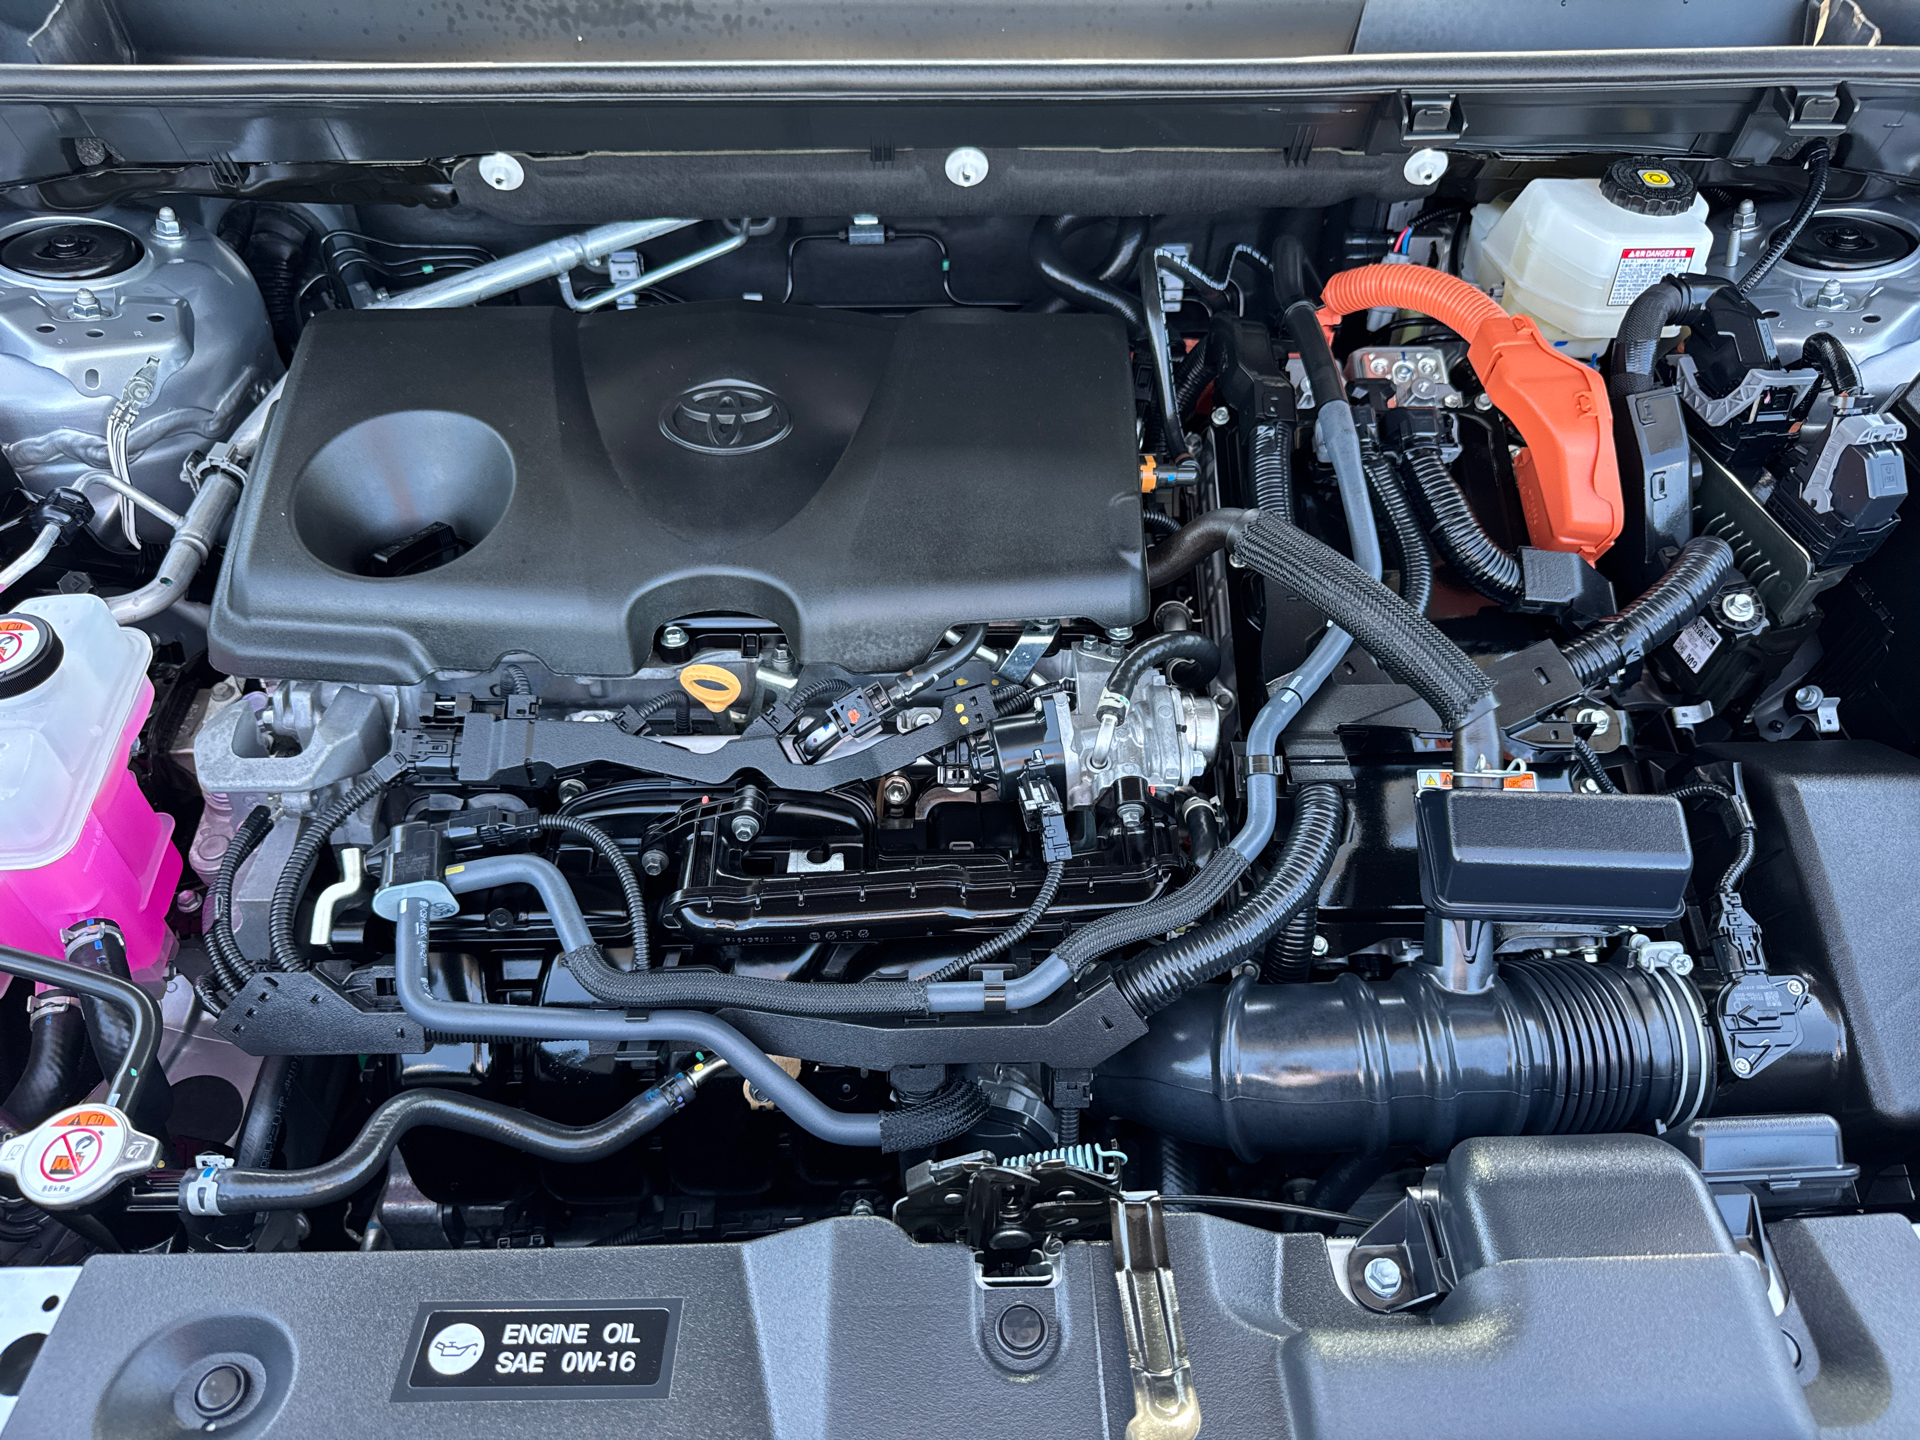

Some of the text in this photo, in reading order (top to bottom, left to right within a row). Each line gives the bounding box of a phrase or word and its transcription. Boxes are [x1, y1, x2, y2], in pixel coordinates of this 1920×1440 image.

[1646, 249, 1674, 258] DANGER
[1684, 653, 1698, 669] M9
[502, 1322, 641, 1344] ENGINE OIL
[495, 1351, 637, 1373] SAE 0W-16
